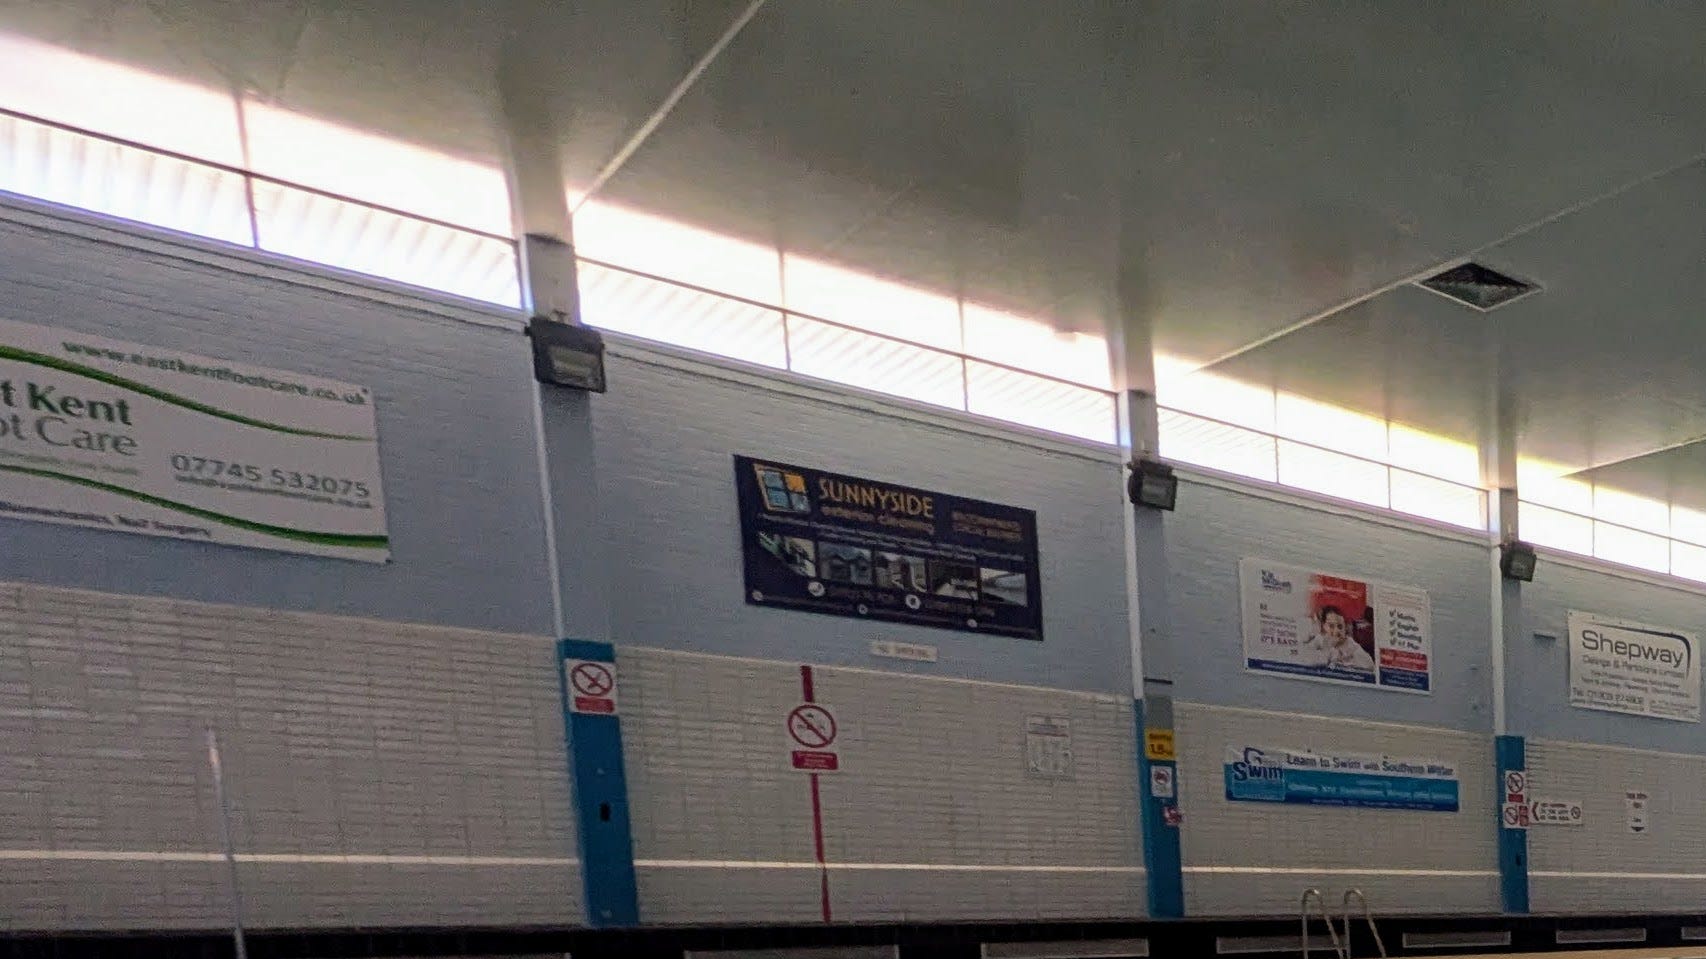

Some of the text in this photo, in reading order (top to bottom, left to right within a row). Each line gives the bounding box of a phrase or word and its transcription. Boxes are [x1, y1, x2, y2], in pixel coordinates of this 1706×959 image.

[27, 382, 133, 426] Kent
[35, 416, 138, 456] Care
[171, 454, 262, 482] 07745
[818, 478, 935, 518] SUNNYSIDE
[1582, 630, 1684, 668] Shepway
[1232, 762, 1284, 781] Swim
[1333, 757, 1361, 770] Swim
